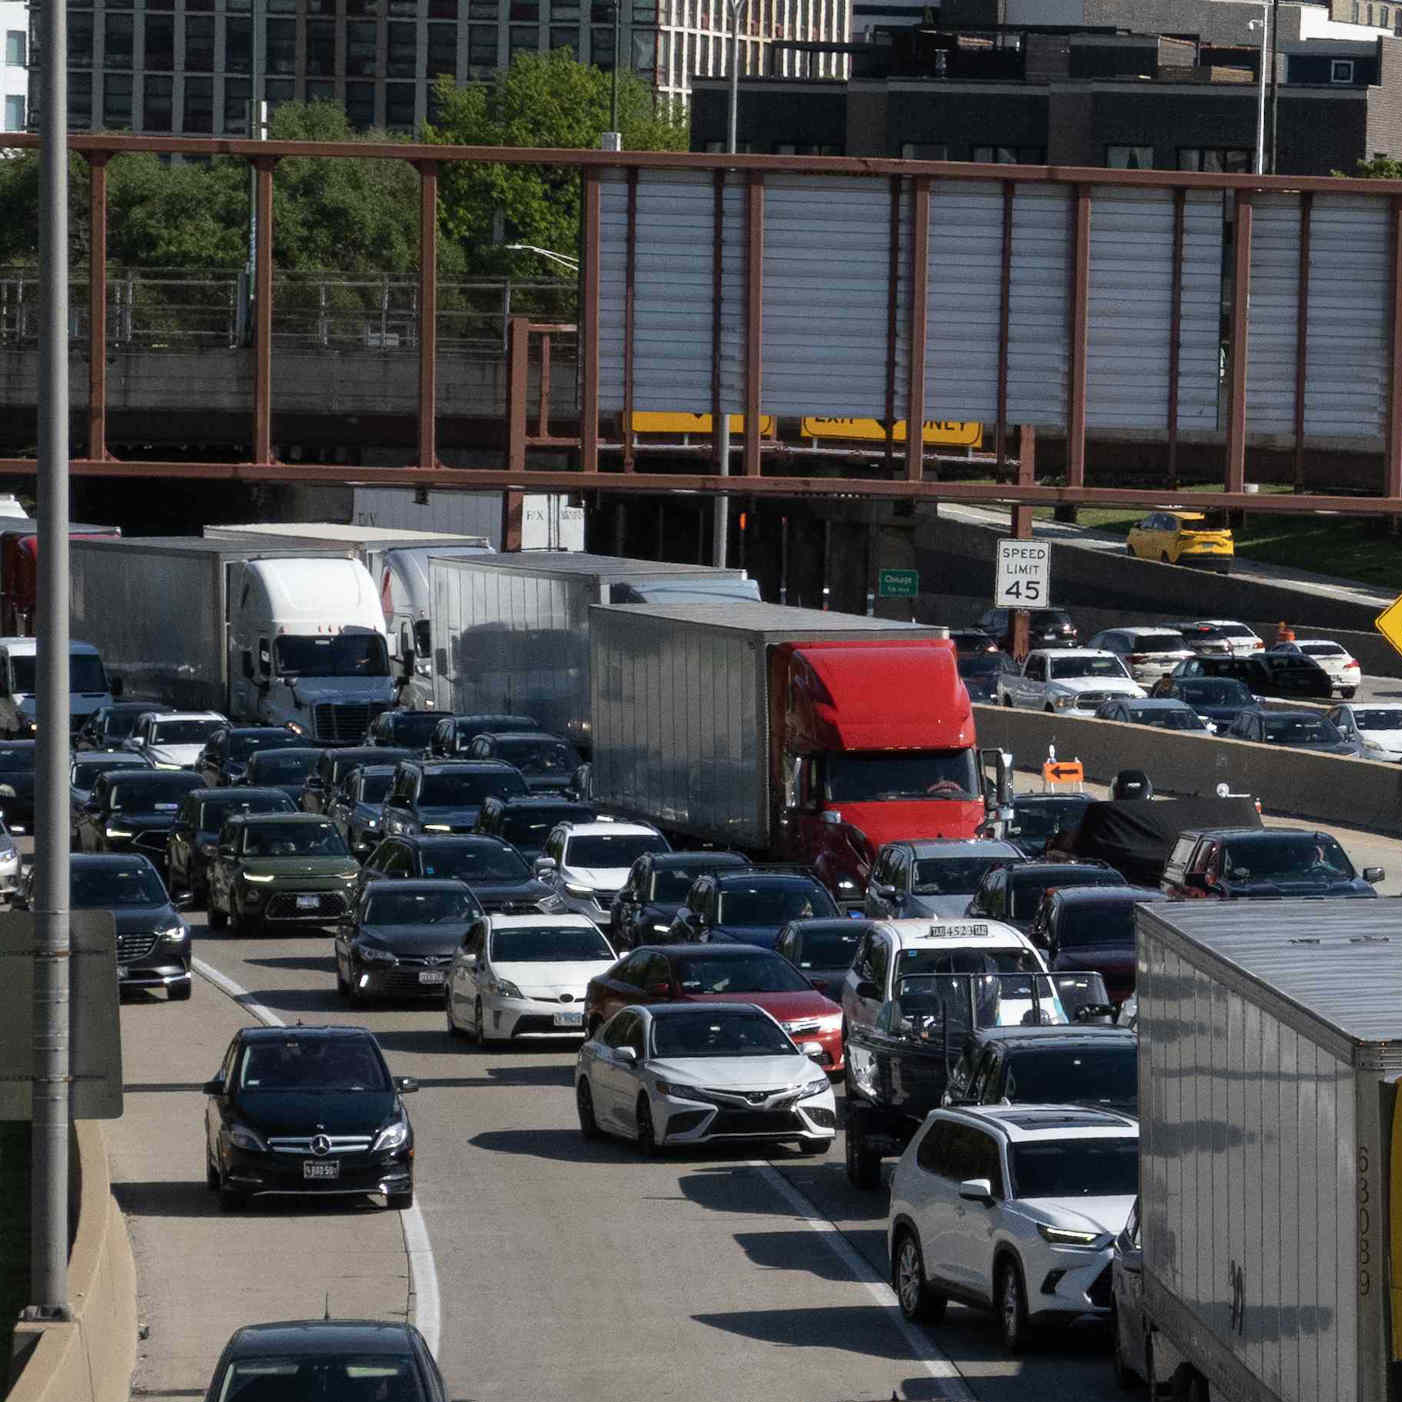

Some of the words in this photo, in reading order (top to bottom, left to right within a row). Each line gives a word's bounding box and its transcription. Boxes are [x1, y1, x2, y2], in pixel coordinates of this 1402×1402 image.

[1003, 548, 1046, 560] SPEED
[1006, 565, 1040, 575] LIMIT
[1005, 580, 1041, 600] 45
[1359, 1146, 1370, 1296] 63089
